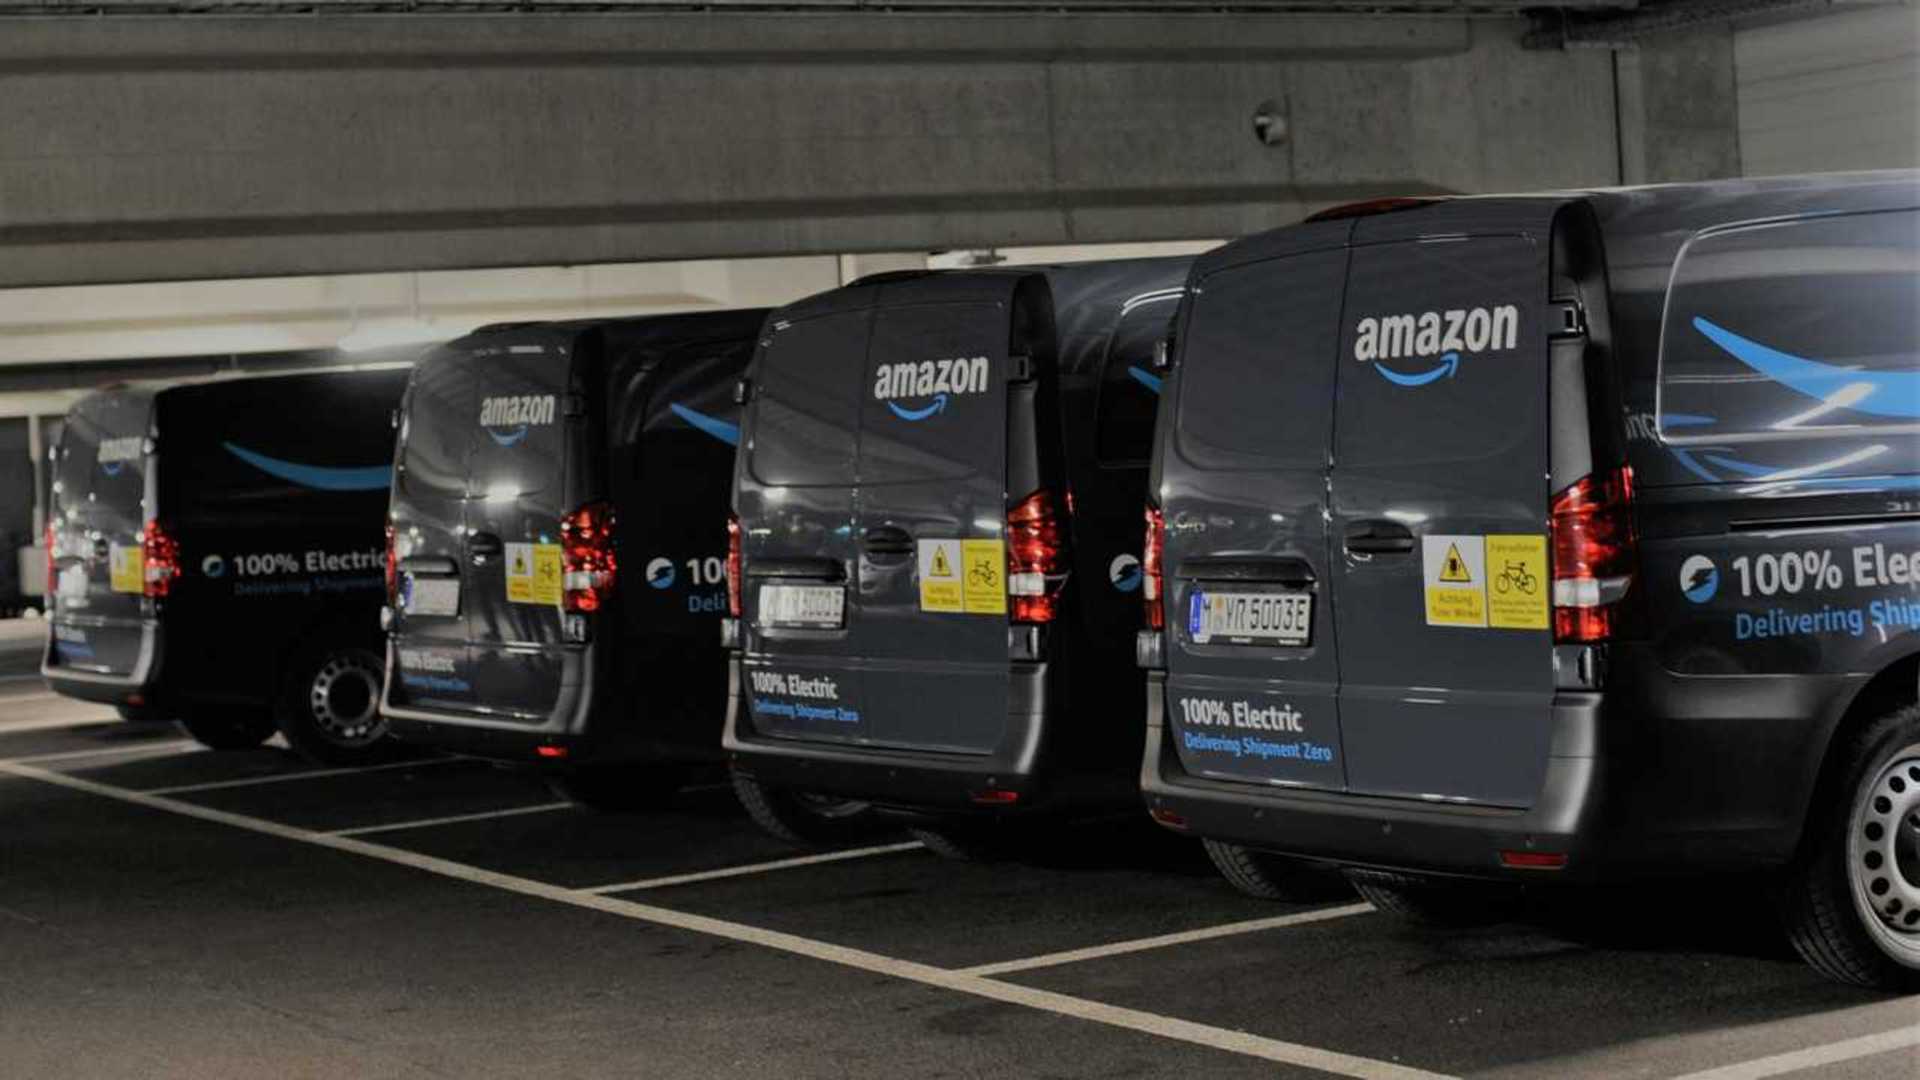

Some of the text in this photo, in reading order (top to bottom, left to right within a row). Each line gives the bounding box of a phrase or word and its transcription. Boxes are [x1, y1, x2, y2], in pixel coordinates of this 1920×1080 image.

[1354, 305, 1518, 361] amazon
[874, 357, 989, 399] amazon
[480, 394, 555, 427] amazon
[233, 553, 299, 575] 100%
[1732, 550, 1843, 597] 100%
[1250, 597, 1306, 632] 5003E
[1735, 605, 1864, 640] Delivering
[751, 671, 838, 699] 100% Electric
[1180, 698, 1303, 732] 100% Electric
[1184, 731, 1332, 761] Delivering Shipment Zero
